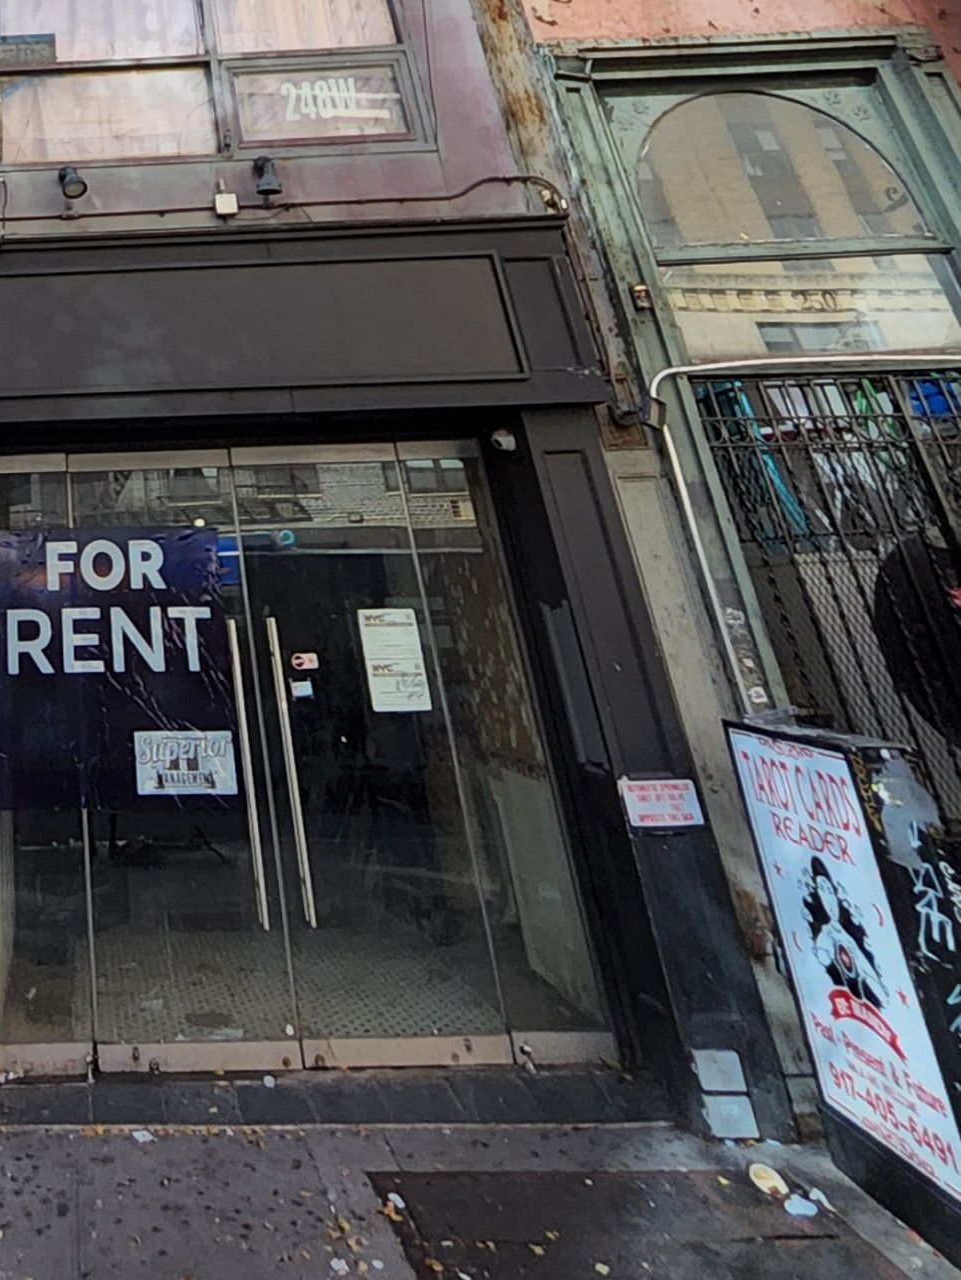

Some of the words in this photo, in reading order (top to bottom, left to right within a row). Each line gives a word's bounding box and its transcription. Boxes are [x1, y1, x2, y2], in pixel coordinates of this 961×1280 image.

[791, 290, 837, 312] 250
[45, 539, 167, 591] FOR
[6, 606, 212, 675] RENT
[372, 663, 394, 673] NYC
[138, 735, 233, 769] Superior
[740, 750, 799, 816] TAROT
[794, 764, 862, 838] CARDS
[770, 810, 857, 867] READER
[829, 1060, 960, 1175] 917-405-6491
